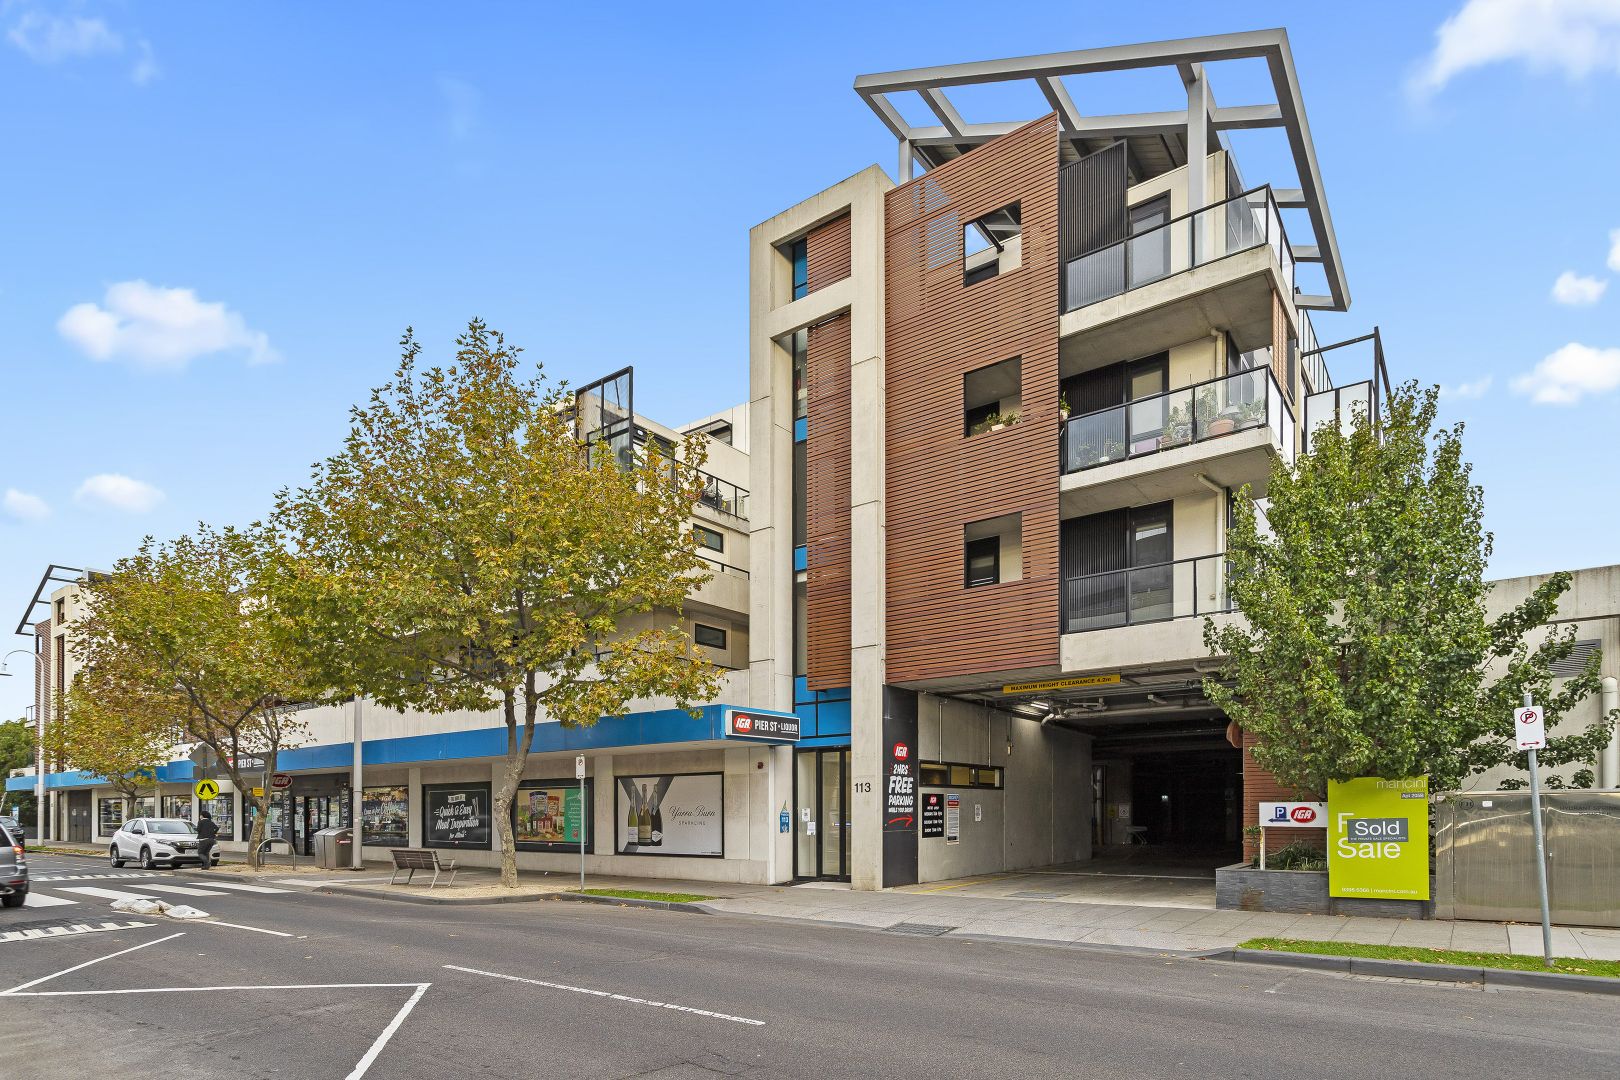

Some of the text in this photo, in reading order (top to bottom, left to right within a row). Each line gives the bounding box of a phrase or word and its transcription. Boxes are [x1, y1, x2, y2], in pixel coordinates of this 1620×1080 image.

[1010, 683, 1038, 691] MAXIMUM
[1038, 681, 1060, 689] HEIGHT
[1060, 678, 1095, 687] CLEARANCE
[735, 717, 798, 732] IGA PIER ST LIQUOR
[895, 746, 908, 757] IGA
[893, 763, 909, 775] 2HRS
[854, 782, 871, 793] 113
[888, 776, 914, 794] FREE
[1376, 778, 1426, 789] mancini
[888, 795, 914, 806] PARKING
[440, 804, 454, 819] Quick
[459, 803, 473, 820] Easy
[669, 804, 716, 821] Yarra Burn
[1276, 807, 1285, 818] P
[1293, 809, 1313, 819] IGA
[435, 816, 480, 831] Meal Inspiration
[1354, 820, 1400, 836] Sold
[1337, 838, 1401, 859] Sale
